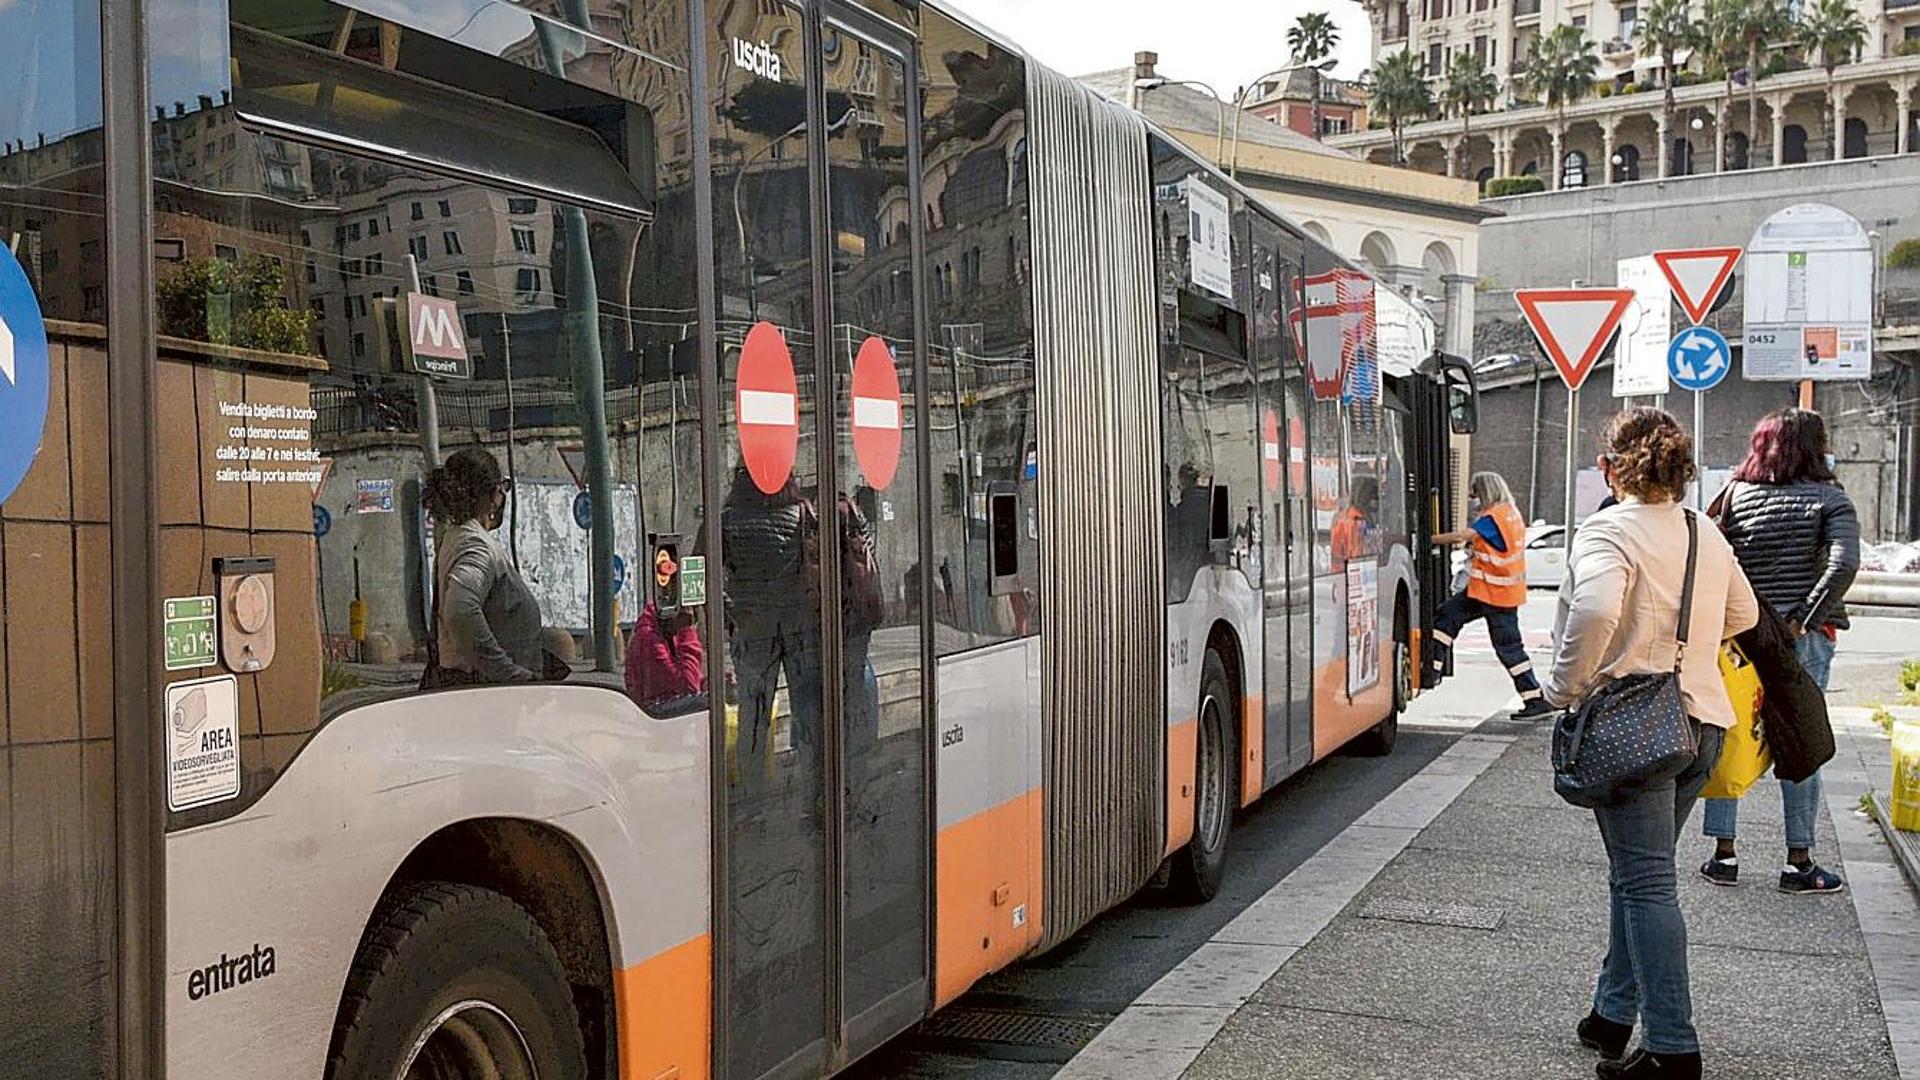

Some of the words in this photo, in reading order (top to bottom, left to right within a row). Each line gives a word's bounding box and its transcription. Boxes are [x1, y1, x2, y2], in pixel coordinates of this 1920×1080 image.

[733, 37, 781, 83] uscita
[1749, 335, 1776, 345] 0452
[219, 401, 252, 417] Vendita
[253, 403, 285, 421] biglietti
[286, 408, 292, 419] a
[293, 406, 318, 420] bordo
[229, 426, 246, 439] con
[247, 424, 277, 439] denaro
[278, 427, 309, 441] contato
[216, 445, 238, 460] dalle
[239, 446, 250, 460] 20
[251, 446, 266, 460] alle
[267, 447, 273, 460] 7
[273, 450, 280, 460] e
[280, 446, 293, 461] nei
[216, 466, 240, 481] salire
[241, 467, 262, 482] dalla
[262, 469, 286, 485] porta
[287, 468, 322, 483] anteriore
[201, 727, 233, 752] AREA
[942, 723, 964, 748] uscita
[173, 749, 234, 772] VIDEOSORVEGLIATA
[188, 943, 276, 1001] entrata
